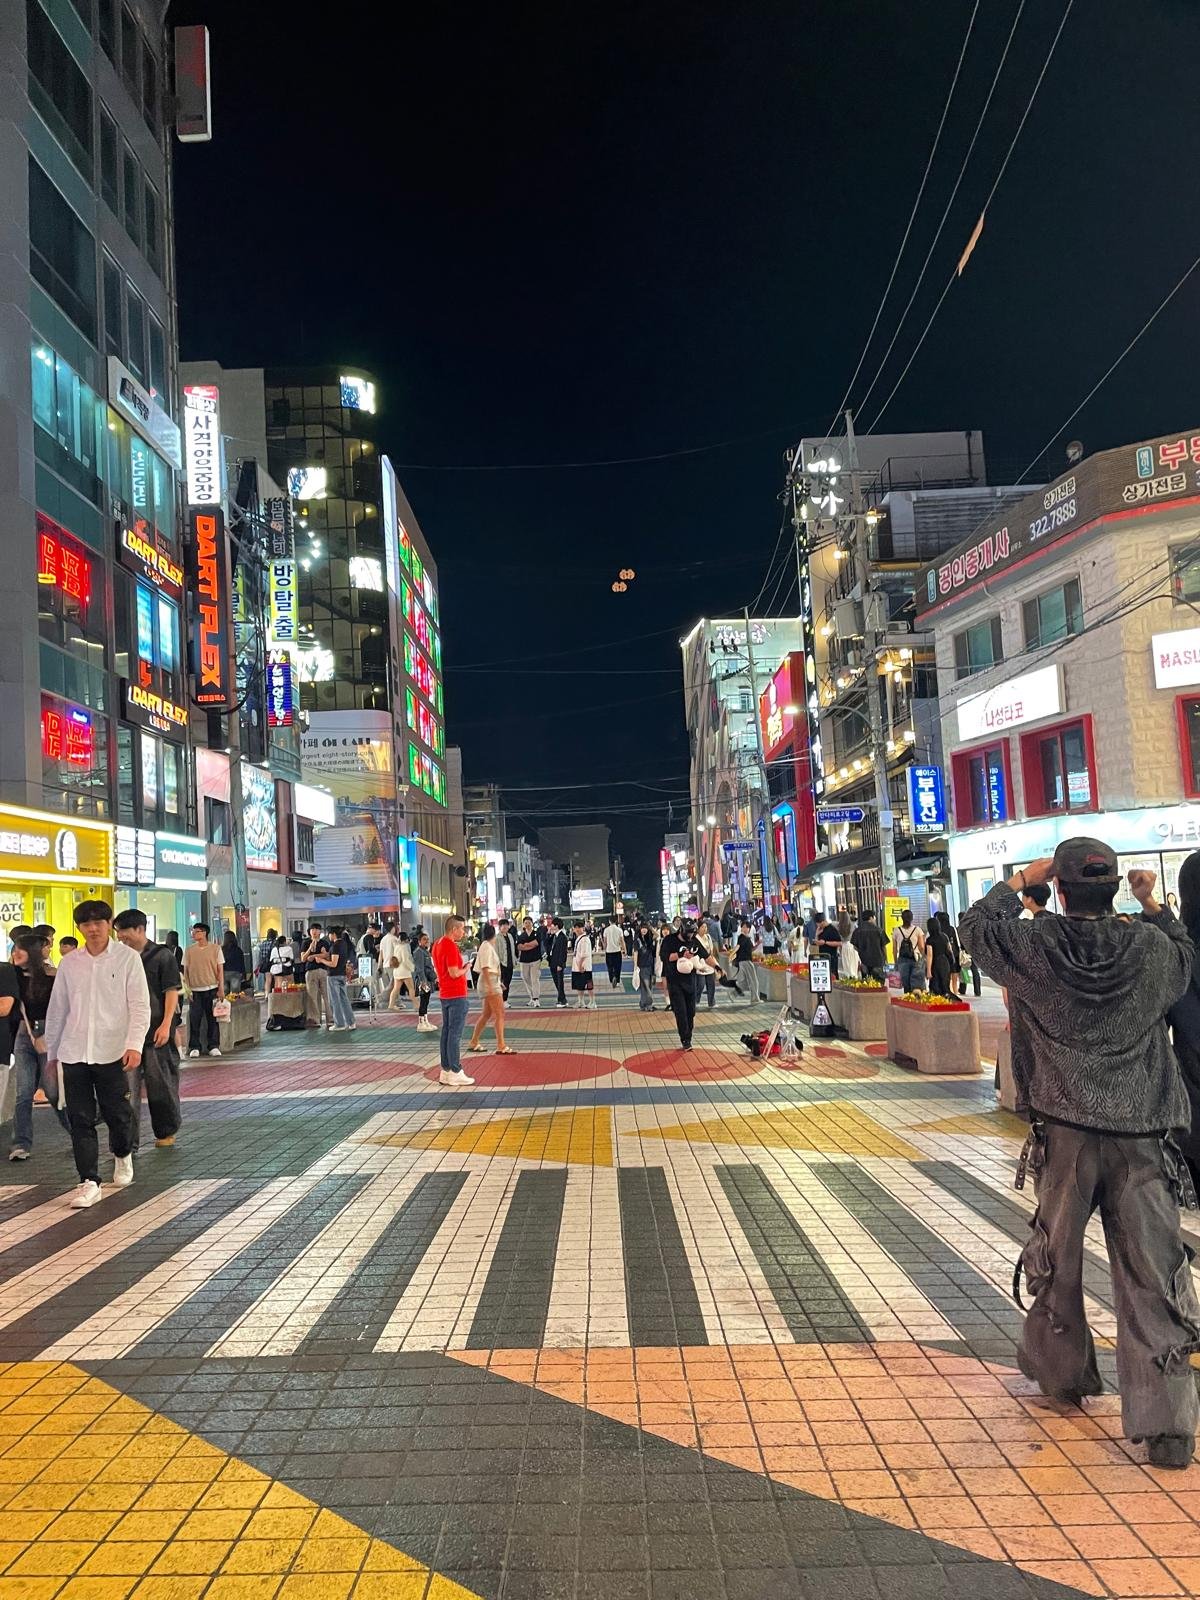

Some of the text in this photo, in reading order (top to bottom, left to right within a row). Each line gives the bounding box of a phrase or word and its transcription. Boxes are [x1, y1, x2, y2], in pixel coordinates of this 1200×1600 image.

[1043, 476, 1076, 510] 상가전문
[1122, 472, 1187, 503] 상가전문
[1028, 498, 1077, 542] 322.7888
[125, 529, 158, 571] DART
[158, 557, 184, 588] FLEX
[938, 526, 1010, 595] 공인중개사
[197, 515, 221, 689] DART FLEX
[274, 565, 294, 639] 방탈출
[129, 685, 162, 717] DART
[163, 700, 188, 727] FLEX
[985, 701, 1024, 728] 나성타코
[915, 769, 937, 777] 에이스
[917, 777, 938, 822] 부동산
